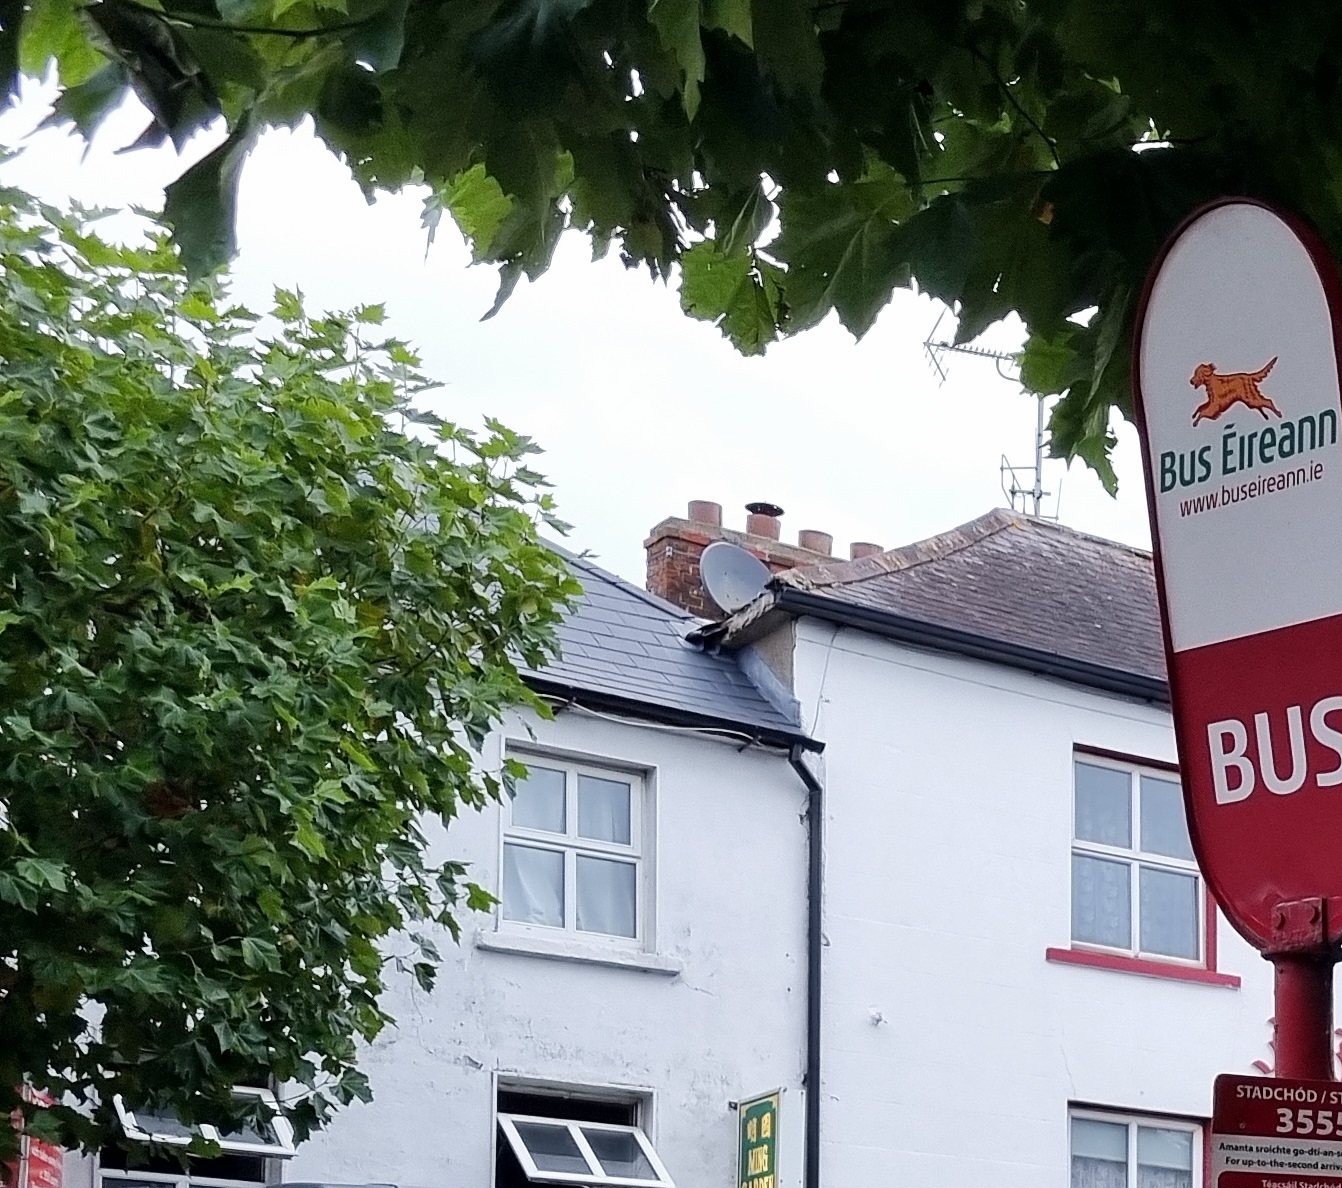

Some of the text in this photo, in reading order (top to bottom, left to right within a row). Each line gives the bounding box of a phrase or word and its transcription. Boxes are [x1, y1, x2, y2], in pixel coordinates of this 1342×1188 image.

[1160, 408, 1338, 494] Bus Éireann
[1179, 460, 1324, 517] www.buseireann.ie
[1236, 1085, 1318, 1103] STADCHÓD
[1321, 1090, 1327, 1104] /
[1219, 1142, 1254, 1152] Amanta
[1225, 1156, 1240, 1165] For
[1242, 1158, 1318, 1170] up-to-the-second
